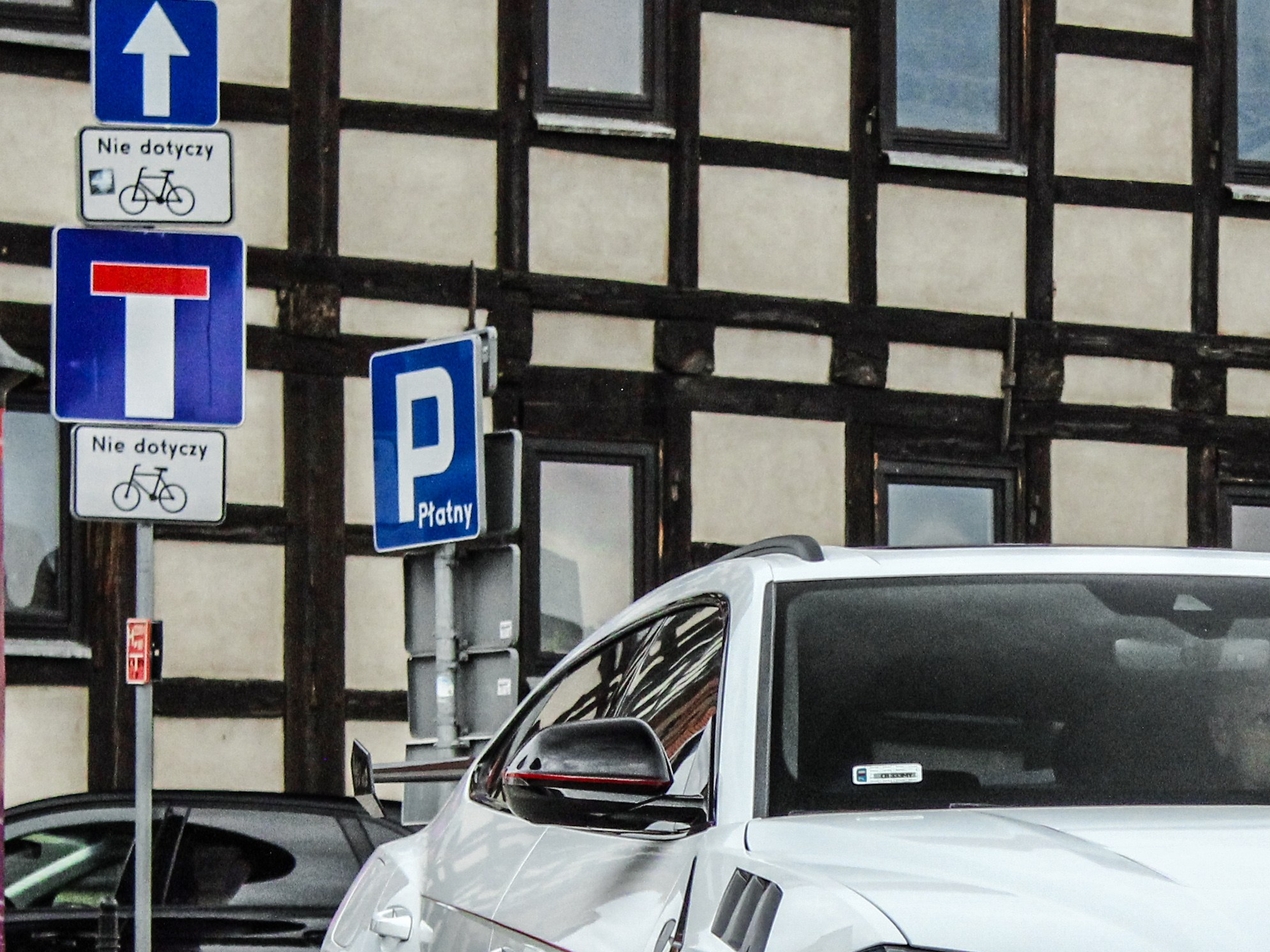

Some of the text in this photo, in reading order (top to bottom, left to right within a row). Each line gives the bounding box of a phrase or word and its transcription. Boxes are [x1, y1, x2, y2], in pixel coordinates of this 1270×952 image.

[98, 138, 214, 160] Nie dotyczy
[92, 437, 208, 460] Nie dotyczy
[395, 366, 455, 524] P
[418, 500, 473, 530] Płatny
